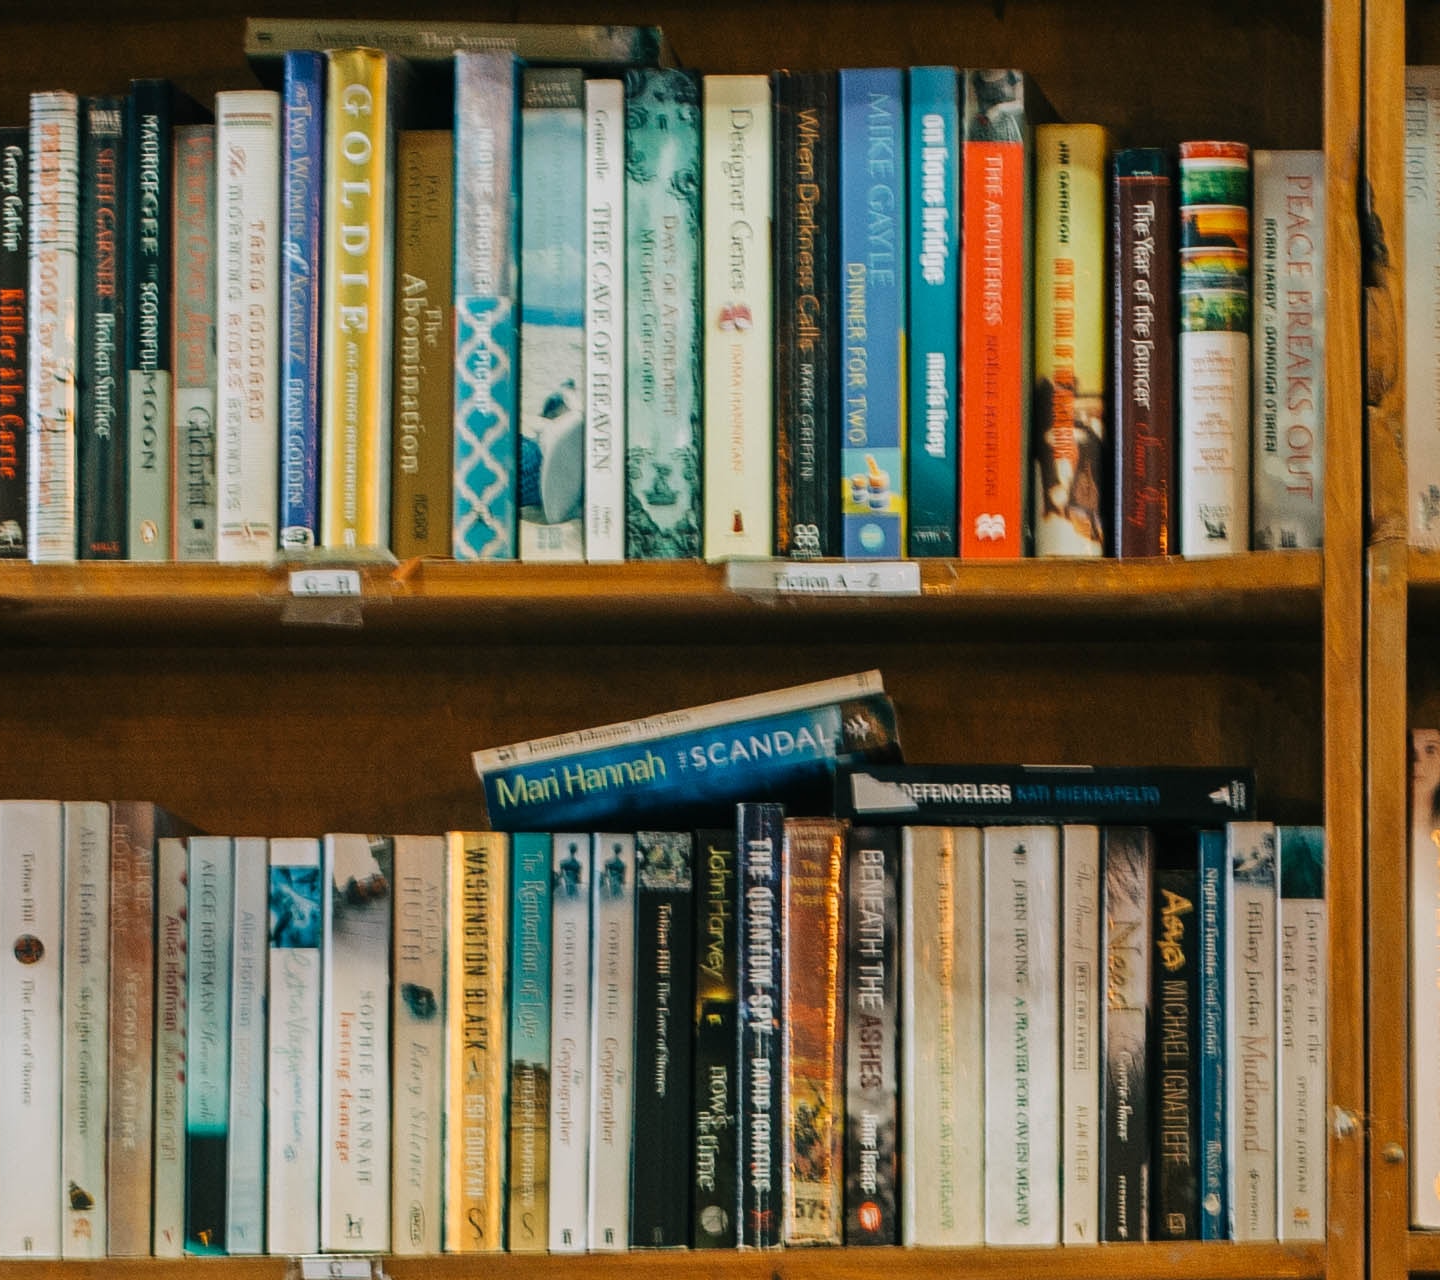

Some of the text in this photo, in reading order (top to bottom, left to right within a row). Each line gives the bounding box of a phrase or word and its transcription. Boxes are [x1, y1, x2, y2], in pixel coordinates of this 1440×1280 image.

[339, 84, 372, 335] GOLDIE
[847, 263, 866, 442] DINNER FOR TWO
[563, 751, 666, 798] Hannah
[690, 723, 838, 771] SCANDAL
[464, 848, 487, 1050] WASHINGTON BLACK
[859, 850, 884, 1089] BENEATH THE ASHES
